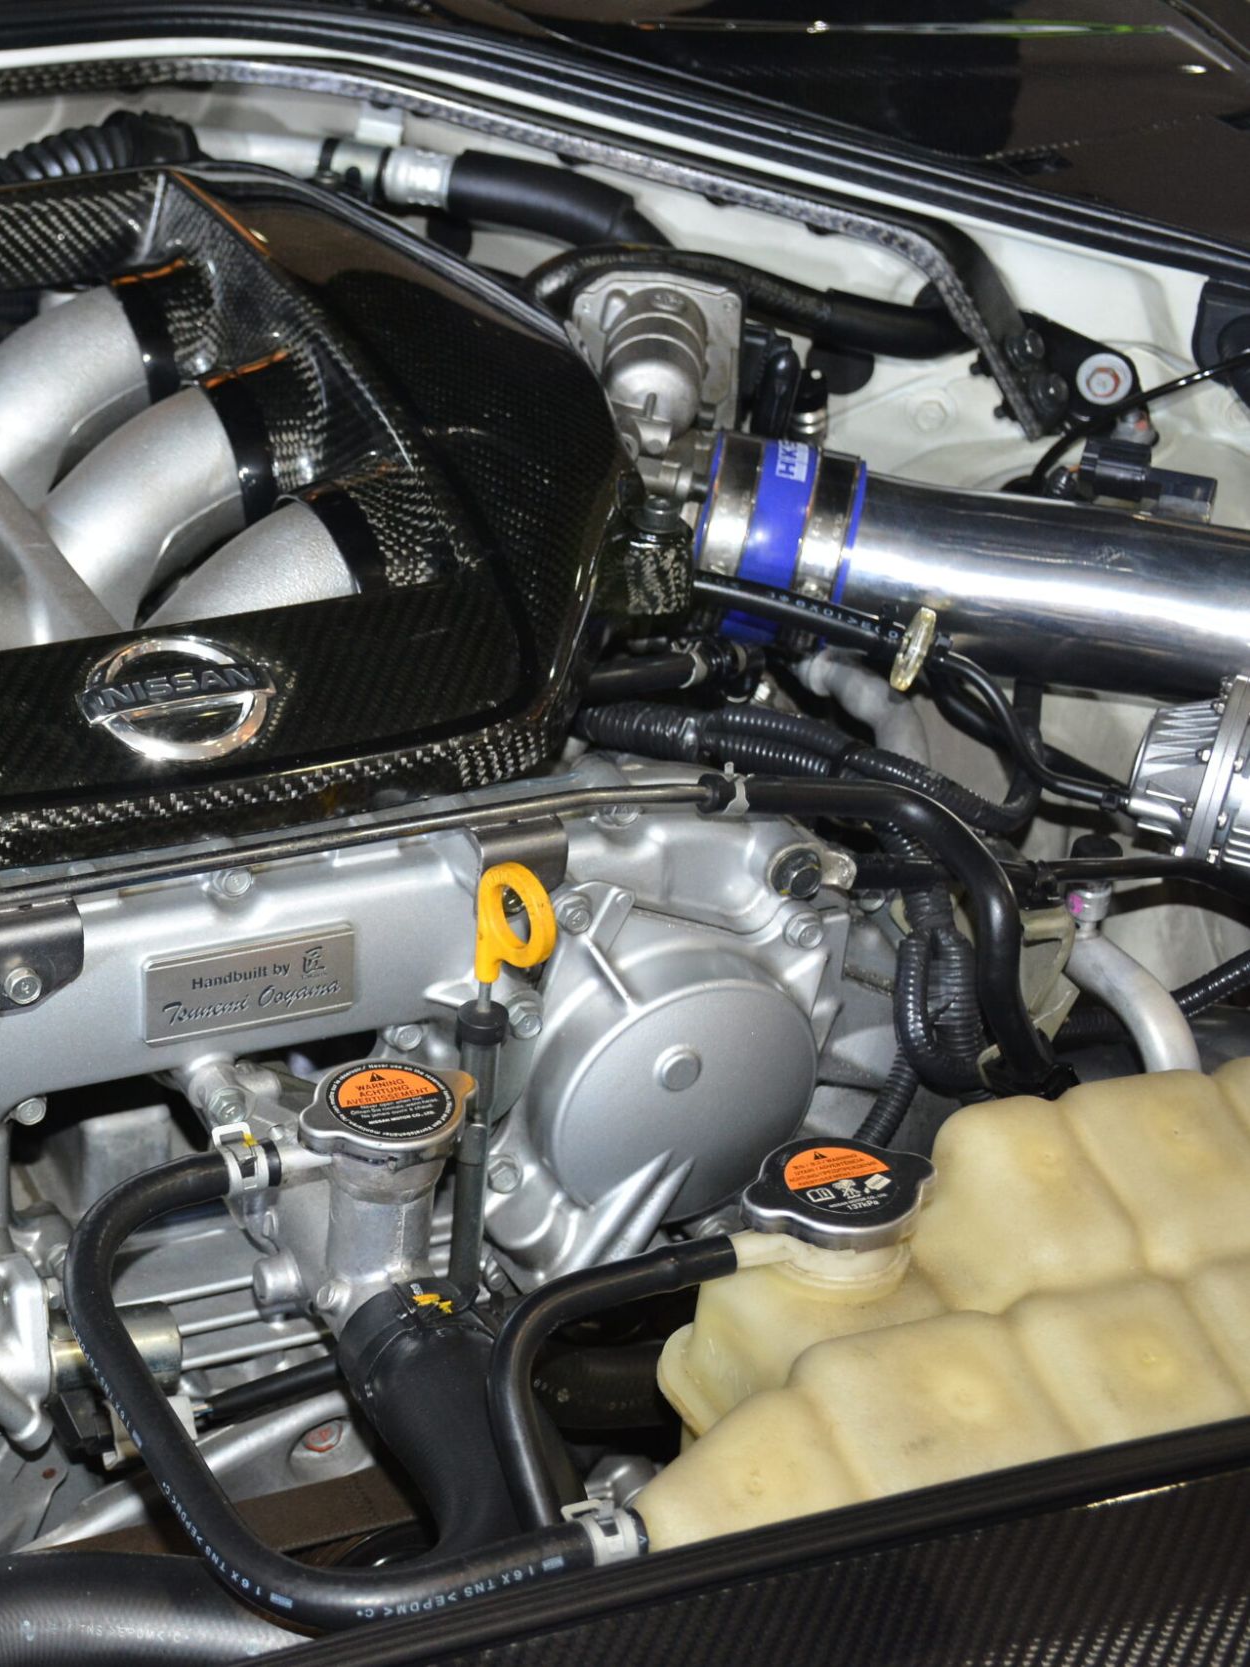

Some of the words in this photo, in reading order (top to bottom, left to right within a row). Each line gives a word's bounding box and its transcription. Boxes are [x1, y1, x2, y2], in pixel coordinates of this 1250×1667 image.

[101, 667, 257, 708] NISSAN
[191, 965, 268, 990] Handbuilt
[273, 962, 291, 977] by
[162, 994, 250, 1026] Tsunemi
[258, 979, 342, 1008] Ooyama
[356, 1078, 405, 1091] WARNING
[359, 1085, 410, 1098] ACHTUNG
[346, 1087, 430, 1106] AVERTISSEMENT
[846, 1200, 880, 1211] 137kPa
[204, 1545, 227, 1573] TNS
[463, 1578, 497, 1598] TNS
